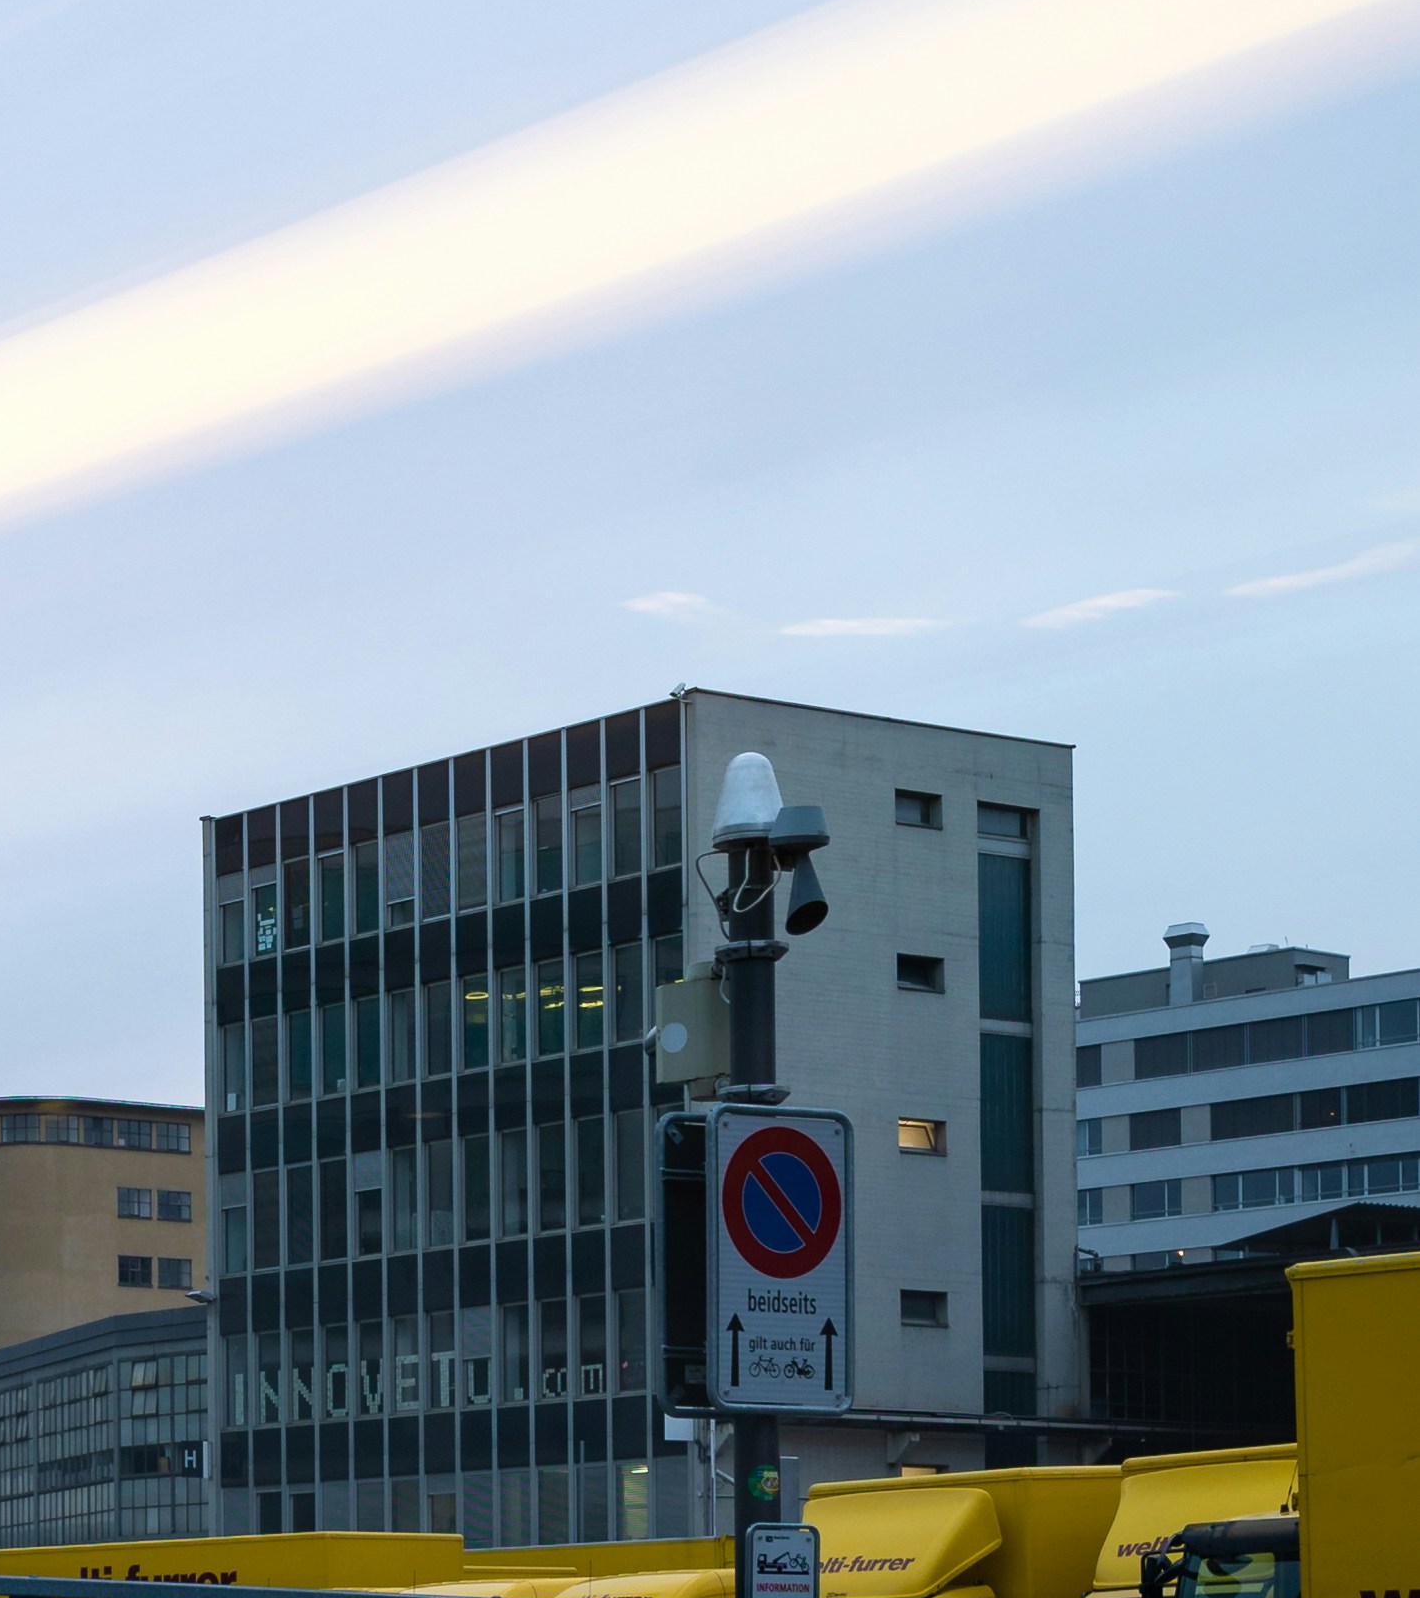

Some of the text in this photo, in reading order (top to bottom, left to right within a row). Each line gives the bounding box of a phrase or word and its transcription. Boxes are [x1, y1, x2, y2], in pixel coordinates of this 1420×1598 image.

[747, 1287, 817, 1315] beidseits
[749, 1336, 816, 1353] gilt auch für
[756, 1582, 810, 1594] INFORMATION
